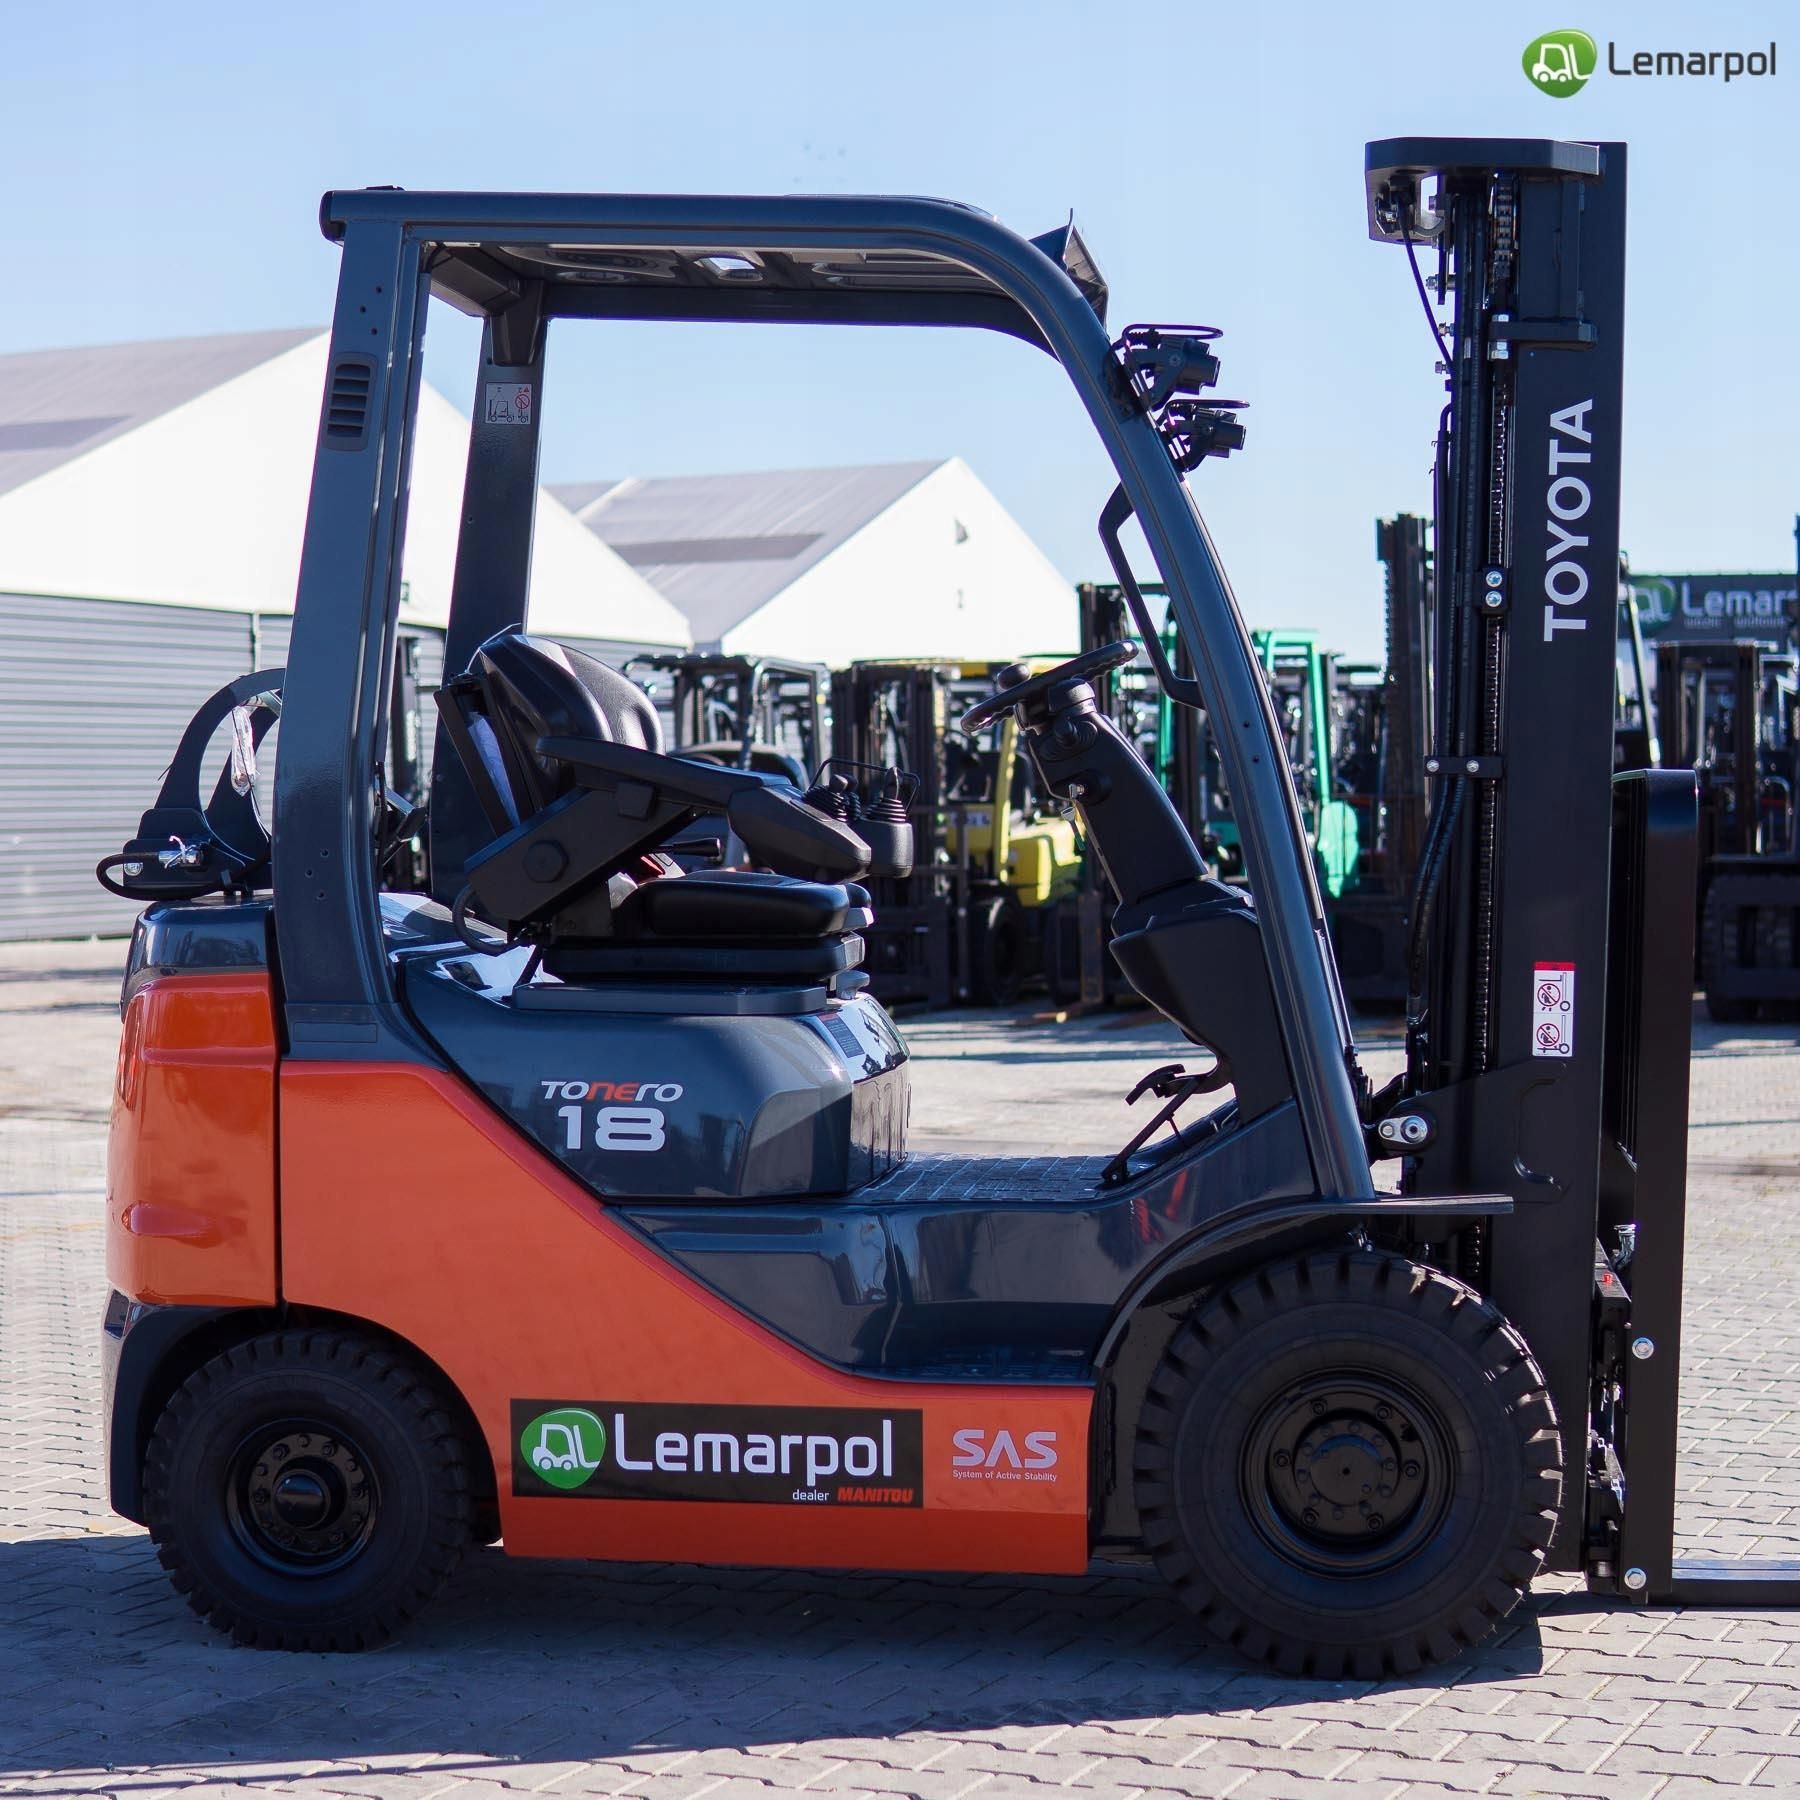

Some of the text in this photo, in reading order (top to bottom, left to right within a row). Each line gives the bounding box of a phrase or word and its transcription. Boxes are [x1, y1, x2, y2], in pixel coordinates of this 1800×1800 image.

[1544, 399, 1592, 641] TOYOTA
[1681, 581, 1798, 617] Lemar
[558, 1105, 666, 1151] 18
[614, 1413, 892, 1487] Lemarpol
[953, 1429, 1057, 1468] SAS
[792, 1487, 914, 1503] dealer MANITOU
[953, 1470, 1057, 1482] System of Active Stability
